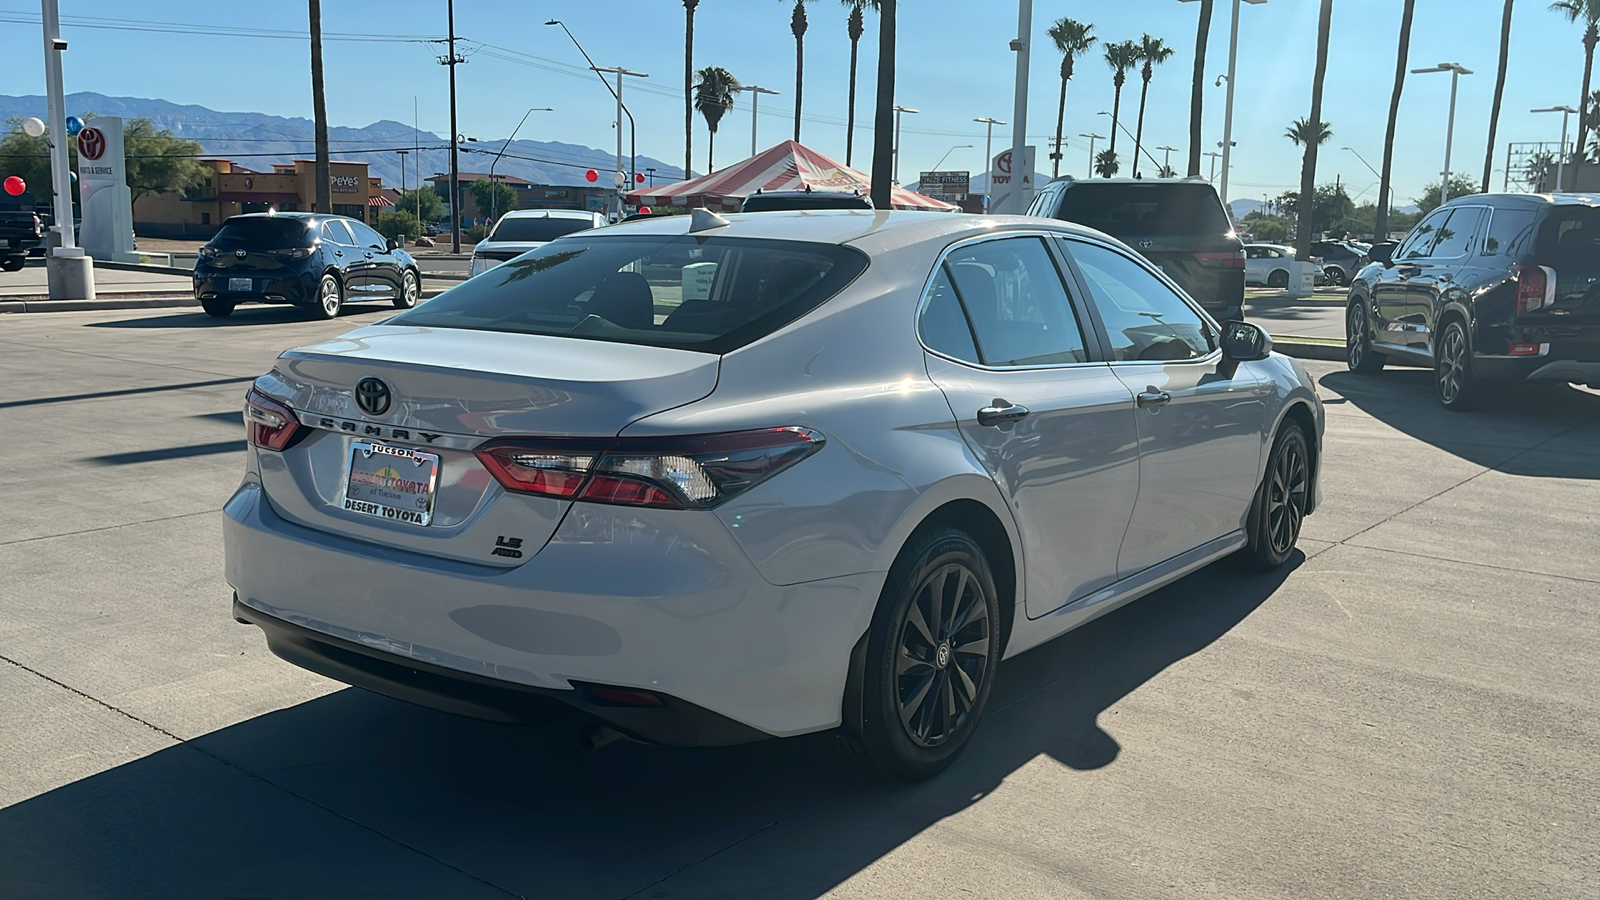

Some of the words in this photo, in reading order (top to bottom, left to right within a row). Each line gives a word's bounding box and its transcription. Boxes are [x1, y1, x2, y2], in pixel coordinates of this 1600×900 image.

[95, 166, 113, 175] SERVICE
[992, 175, 1030, 185] TOYA
[320, 417, 442, 443] CAMRY
[371, 444, 414, 458] TUCSON
[350, 470, 387, 488] DESERT
[390, 477, 429, 495] TOYOTA
[378, 488, 401, 500] Tucson
[344, 499, 379, 515] DESERT
[381, 506, 422, 524] TOYOTA
[495, 535, 523, 549] LE
[490, 547, 523, 559] AWD
